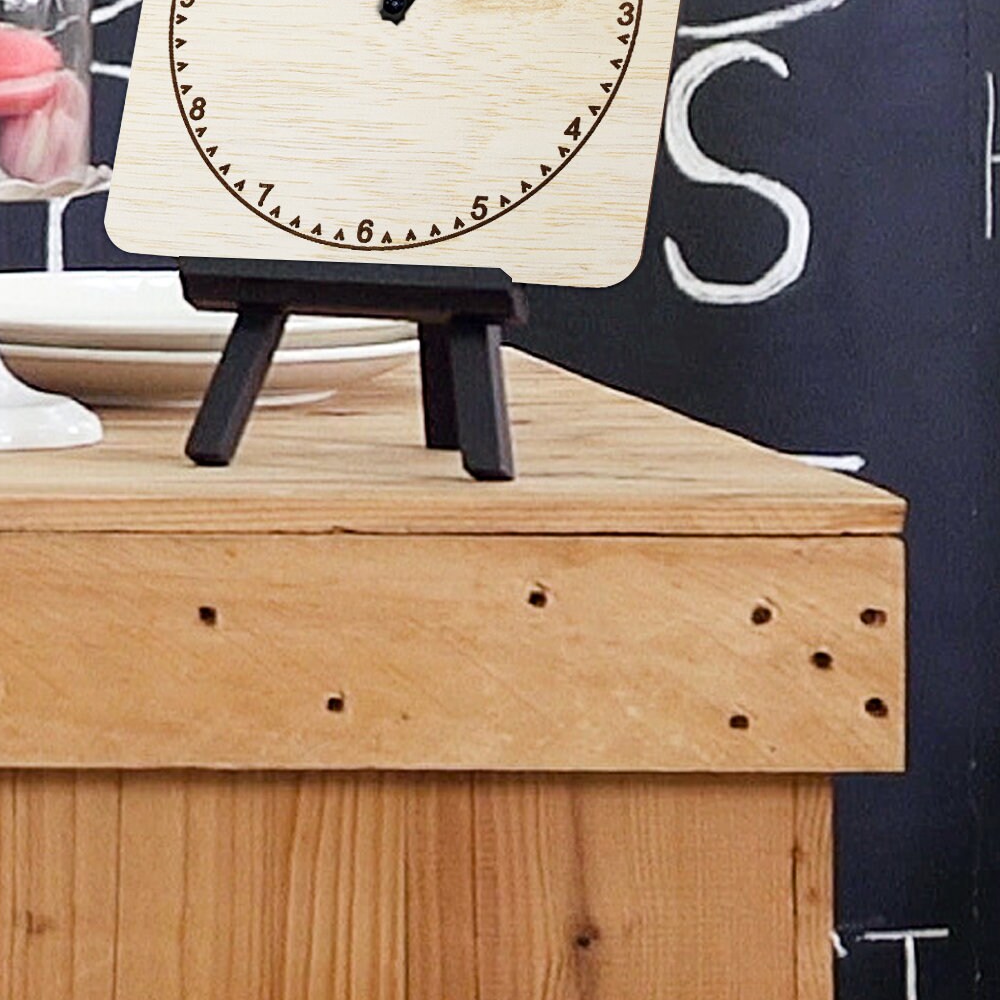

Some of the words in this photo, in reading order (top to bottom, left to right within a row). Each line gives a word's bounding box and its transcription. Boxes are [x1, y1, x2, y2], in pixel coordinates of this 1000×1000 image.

[616, 1, 635, 27] 3
[188, 96, 207, 121] 8
[563, 116, 582, 141] 4
[257, 182, 275, 208] 7
[470, 195, 489, 221] 5
[356, 218, 374, 244] 6
